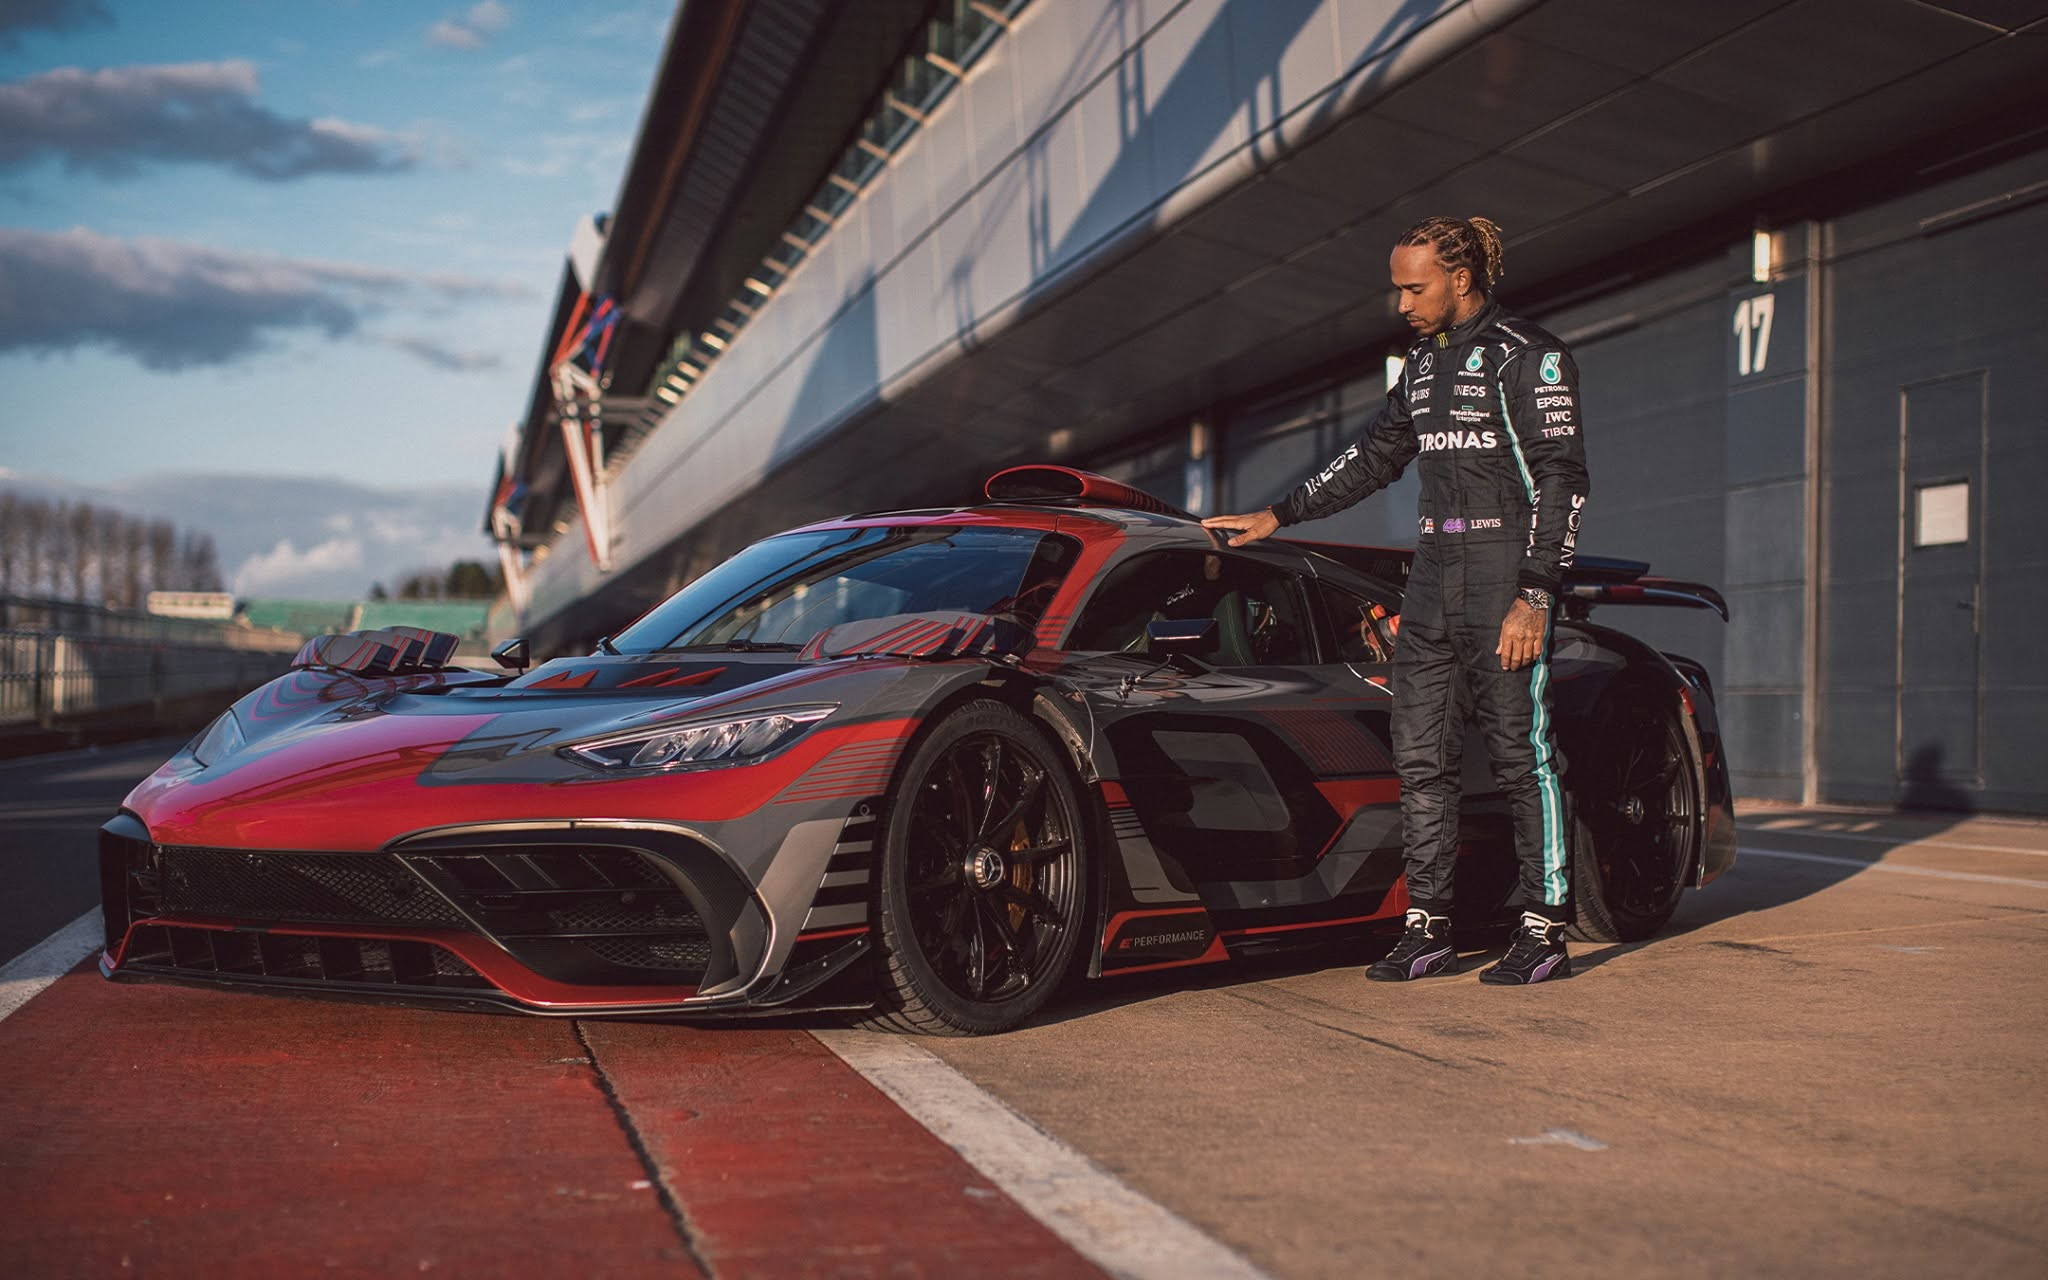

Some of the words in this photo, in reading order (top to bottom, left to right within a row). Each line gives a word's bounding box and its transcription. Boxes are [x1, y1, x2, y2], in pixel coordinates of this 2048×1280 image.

[1733, 294, 1775, 376] 17
[1453, 384, 1487, 398] INEOS
[1536, 395, 1573, 409] EPSON
[1545, 411, 1572, 424] IWC
[1470, 518, 1502, 530] LEWIS
[1560, 494, 1586, 570] INEOS
[1134, 929, 1206, 948] PERFORMANCE
